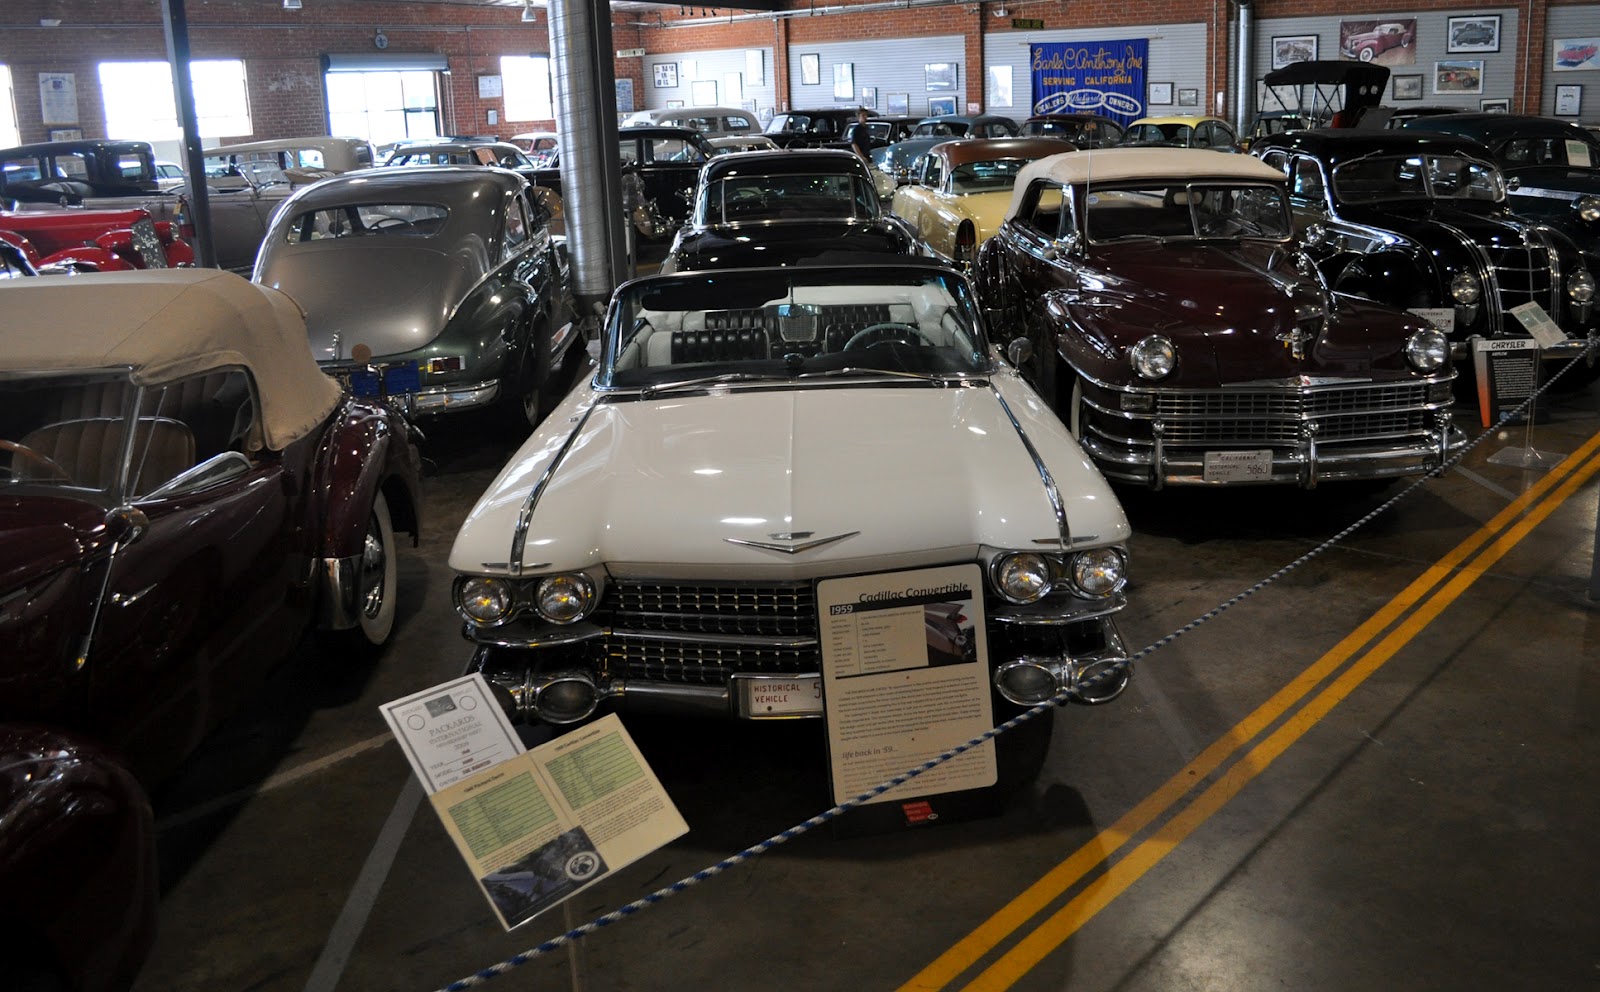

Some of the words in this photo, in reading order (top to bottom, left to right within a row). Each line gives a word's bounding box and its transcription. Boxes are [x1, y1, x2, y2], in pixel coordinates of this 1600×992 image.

[1032, 47, 1063, 71] Earle
[1063, 48, 1076, 70] C
[1075, 47, 1125, 75] Anthony
[1042, 77, 1076, 86] SERVING
[1084, 76, 1132, 86] CALIFORNIA
[1037, 96, 1065, 113] DEALERS
[1108, 97, 1134, 111] OWNERS
[1491, 341, 1526, 349] CHRYSLER
[859, 589, 904, 603] Cadillac
[905, 582, 969, 599] Convertible
[831, 604, 854, 615] 1959
[754, 683, 801, 692] HISTORICAL
[754, 694, 789, 703] VEHICLE
[429, 714, 476, 736] PACKARDS
[428, 721, 482, 744] INTERNATIONAL
[842, 752, 855, 760] life
[854, 750, 872, 758] back
